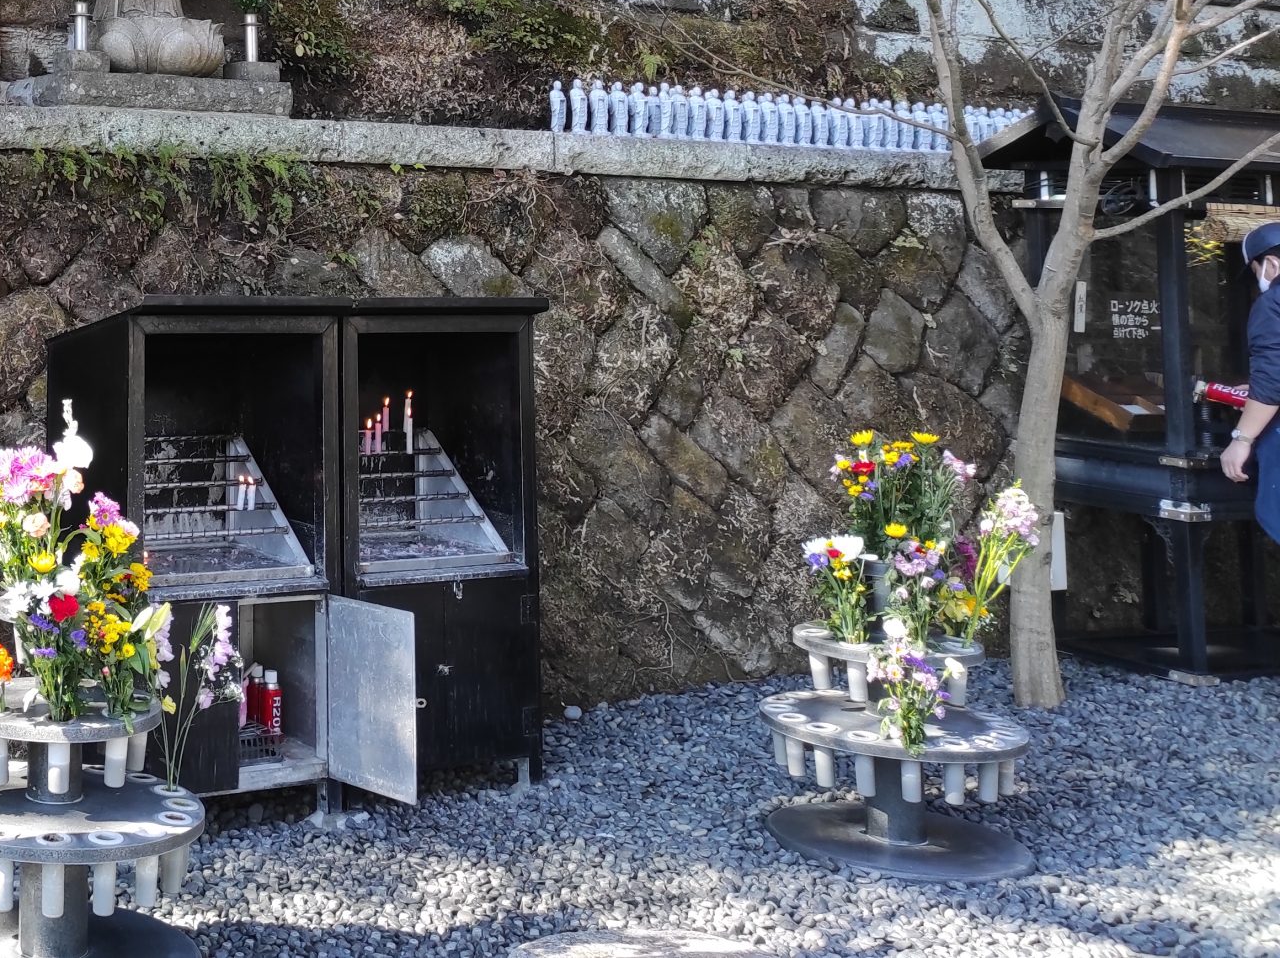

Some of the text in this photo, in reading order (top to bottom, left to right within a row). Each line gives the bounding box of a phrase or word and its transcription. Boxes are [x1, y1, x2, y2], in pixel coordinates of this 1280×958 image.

[1110, 299, 1160, 314] ローソク点火
[1212, 383, 1249, 397] R200
